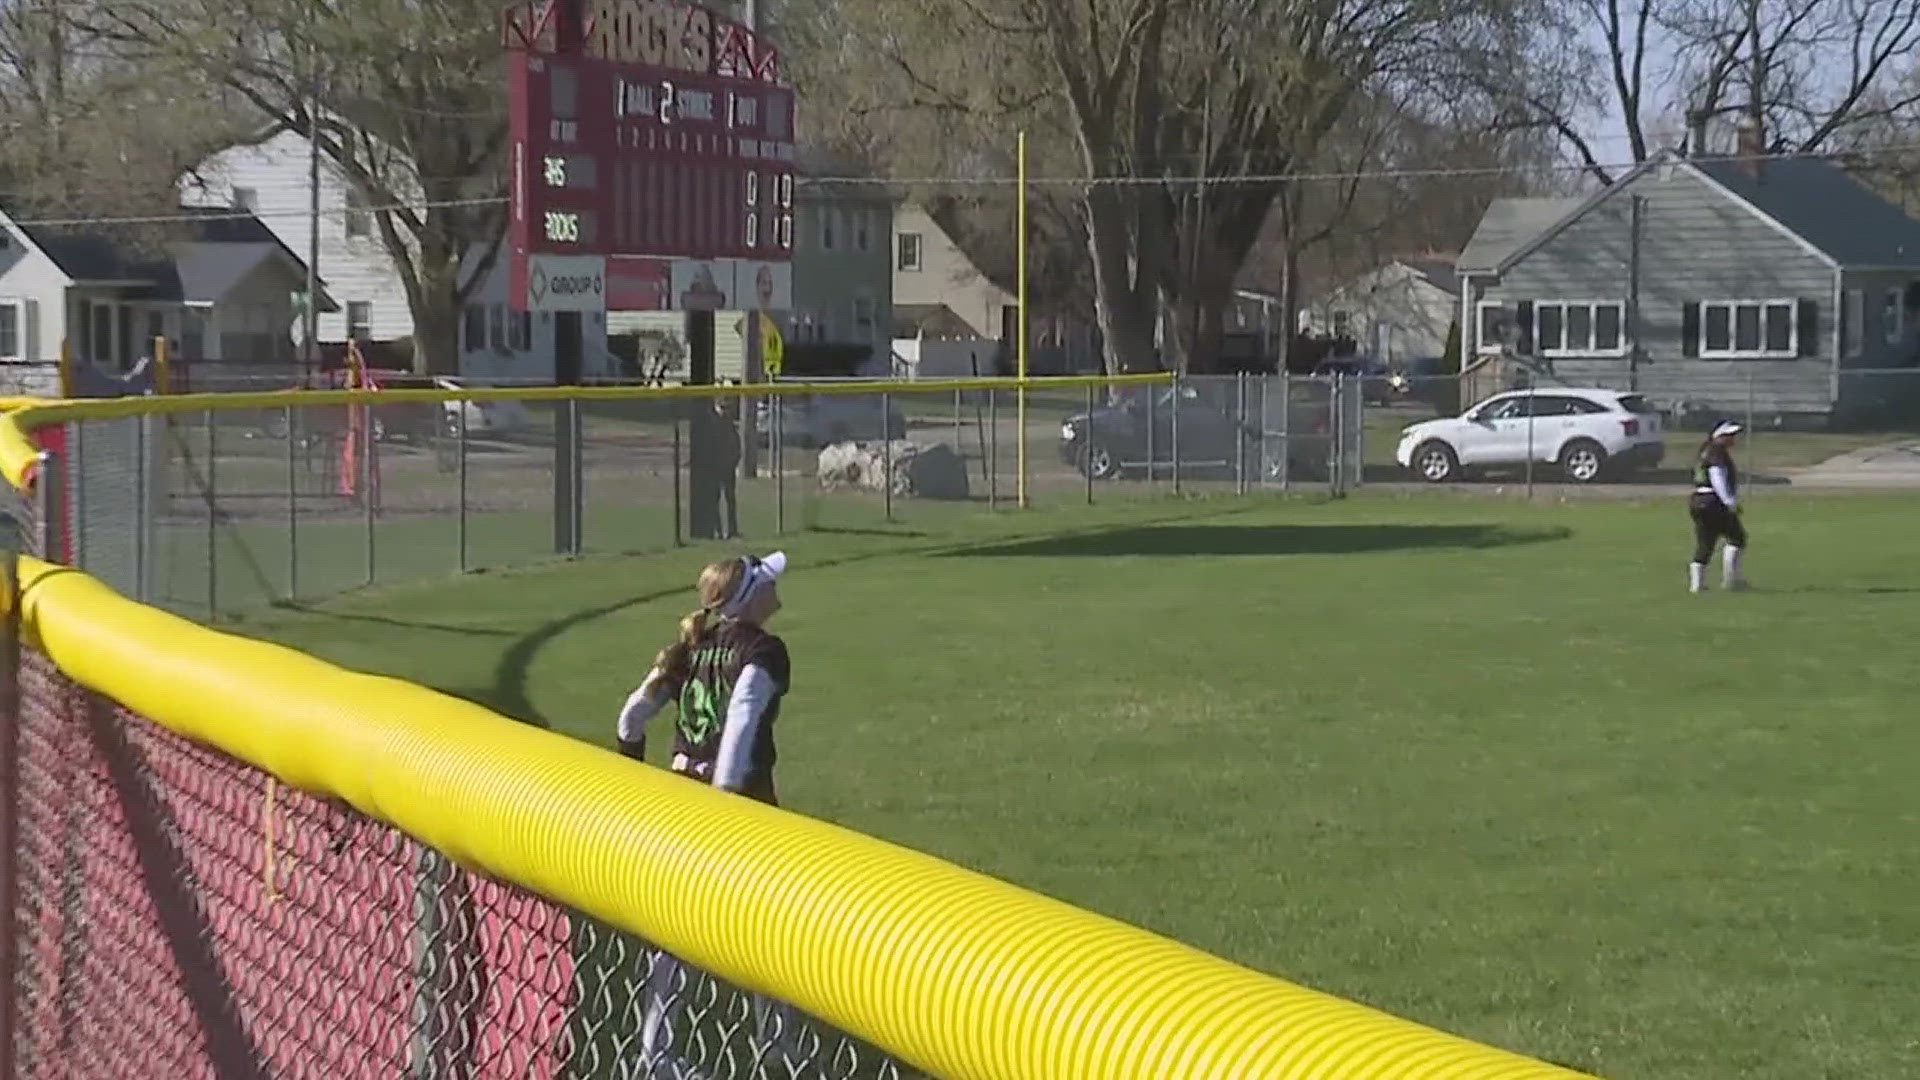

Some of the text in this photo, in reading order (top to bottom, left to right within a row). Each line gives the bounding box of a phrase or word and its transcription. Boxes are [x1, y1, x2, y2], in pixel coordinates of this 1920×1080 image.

[592, 0, 710, 72] ROCKS
[660, 81, 673, 124] 2
[551, 275, 592, 295] GROUP
